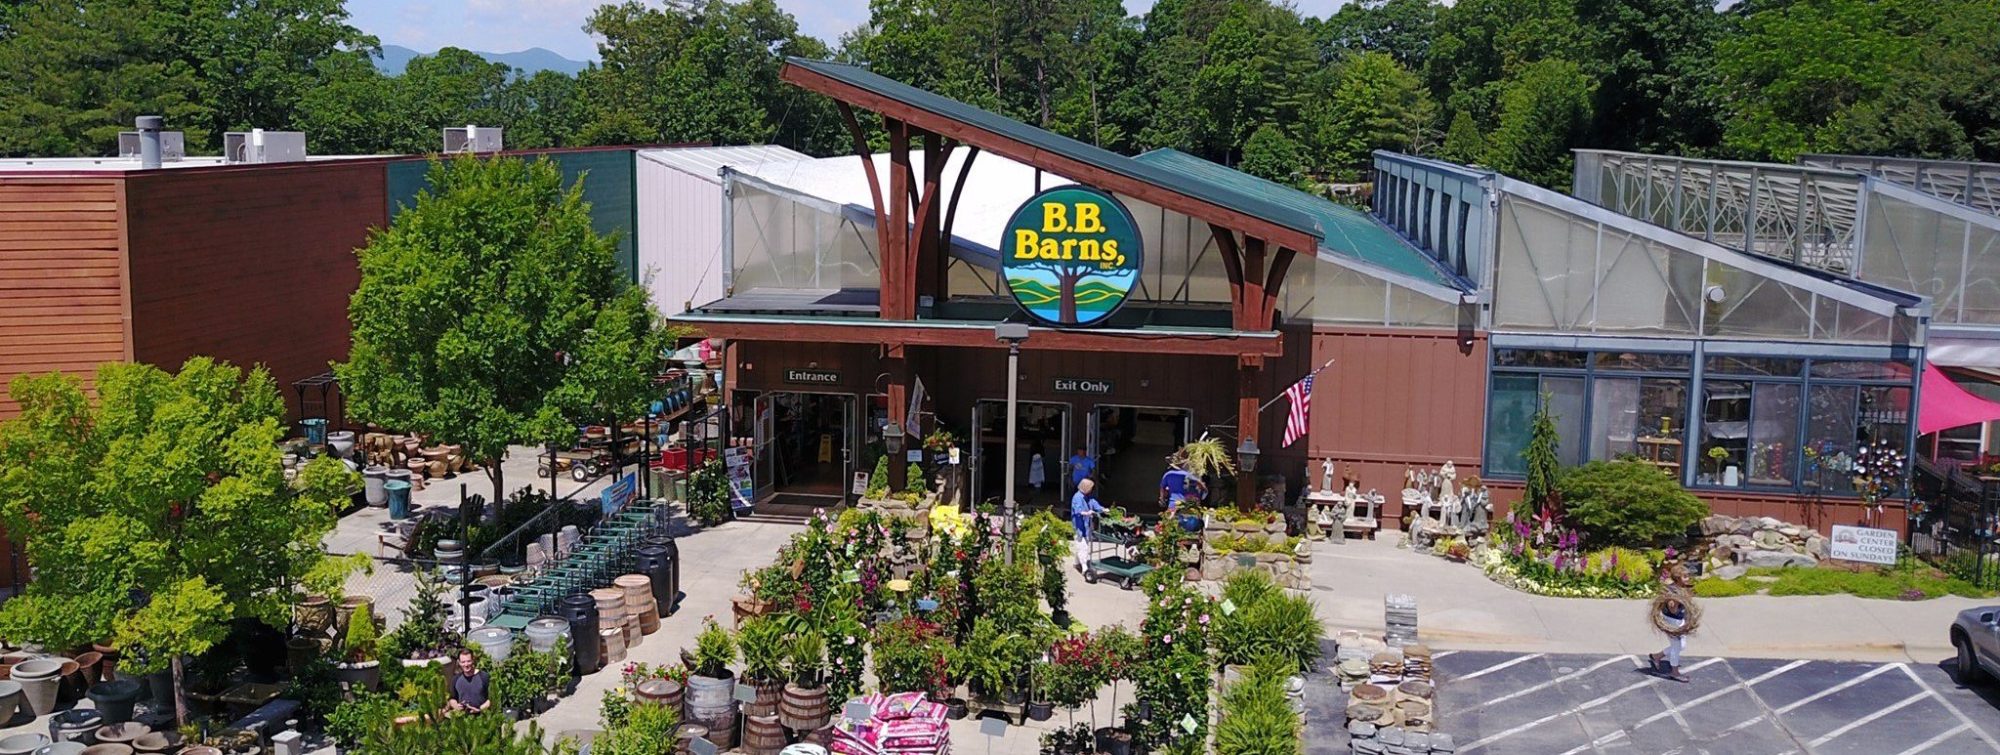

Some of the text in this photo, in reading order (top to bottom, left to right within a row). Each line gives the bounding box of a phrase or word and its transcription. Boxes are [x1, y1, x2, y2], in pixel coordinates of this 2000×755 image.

[1042, 202, 1106, 233] B.B.
[1014, 229, 1125, 266] Barns,
[789, 371, 837, 382] Entrance
[1055, 380, 1109, 393] Exit Only
[1856, 529, 1895, 538] GARDEN
[1860, 538, 1895, 547] CENTER
[1858, 545, 1894, 554] CLOSED
[1833, 550, 1894, 562] ON SUNDAYS
